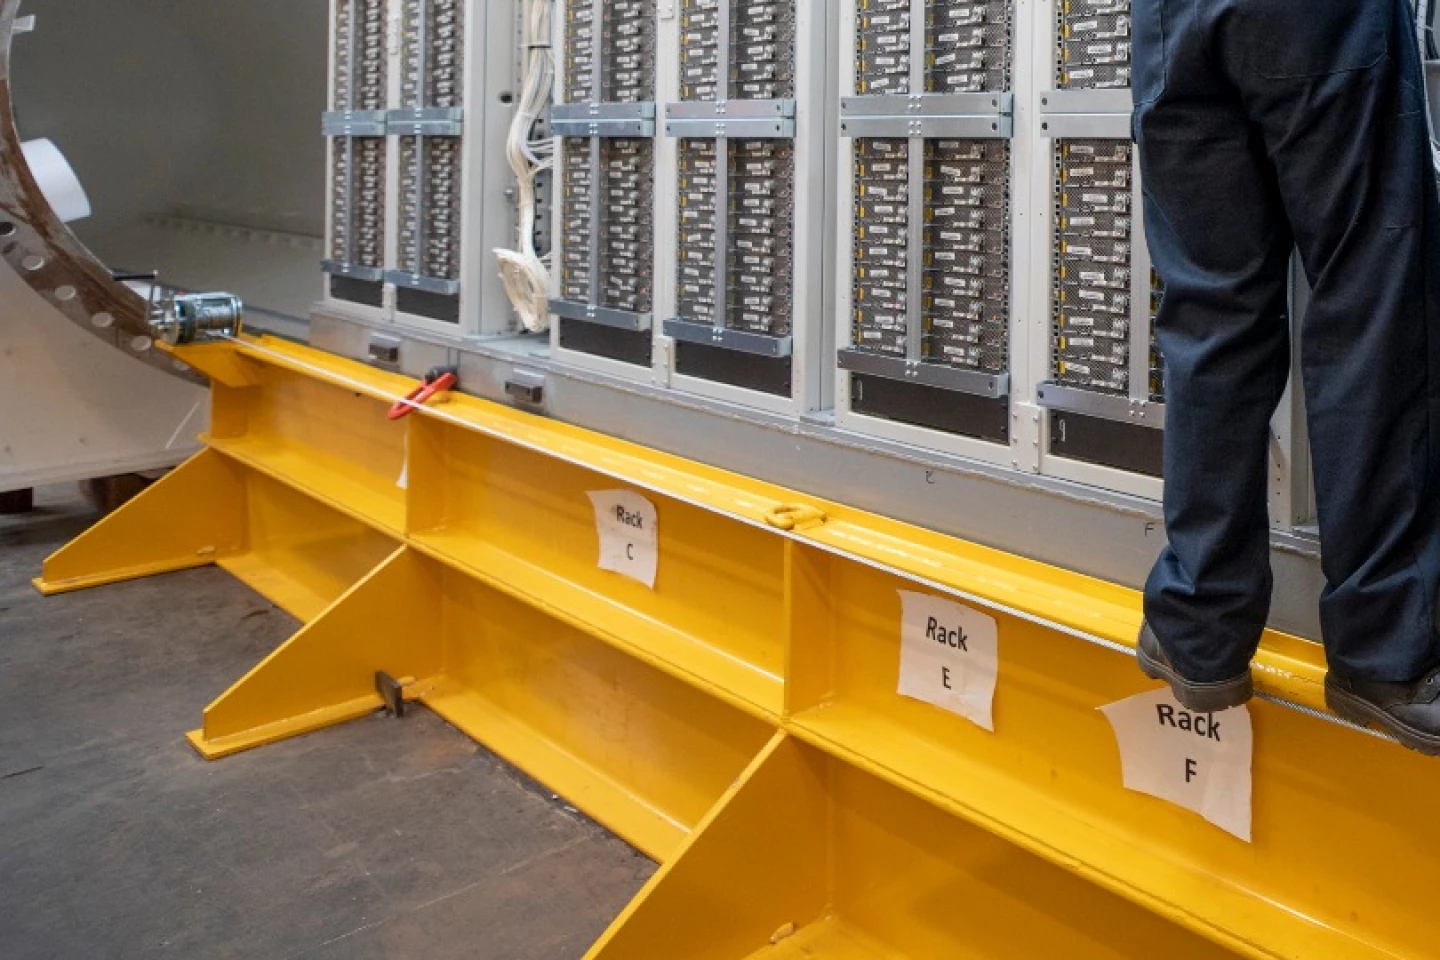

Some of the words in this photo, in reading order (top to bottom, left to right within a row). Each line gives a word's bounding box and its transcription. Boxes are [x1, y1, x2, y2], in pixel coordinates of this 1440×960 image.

[615, 504, 643, 530] Rack
[1143, 521, 1156, 538] F
[625, 543, 634, 561] C
[926, 616, 968, 652] Rack
[941, 666, 952, 690] E
[1155, 703, 1221, 742] Rack
[1184, 758, 1198, 783] F
